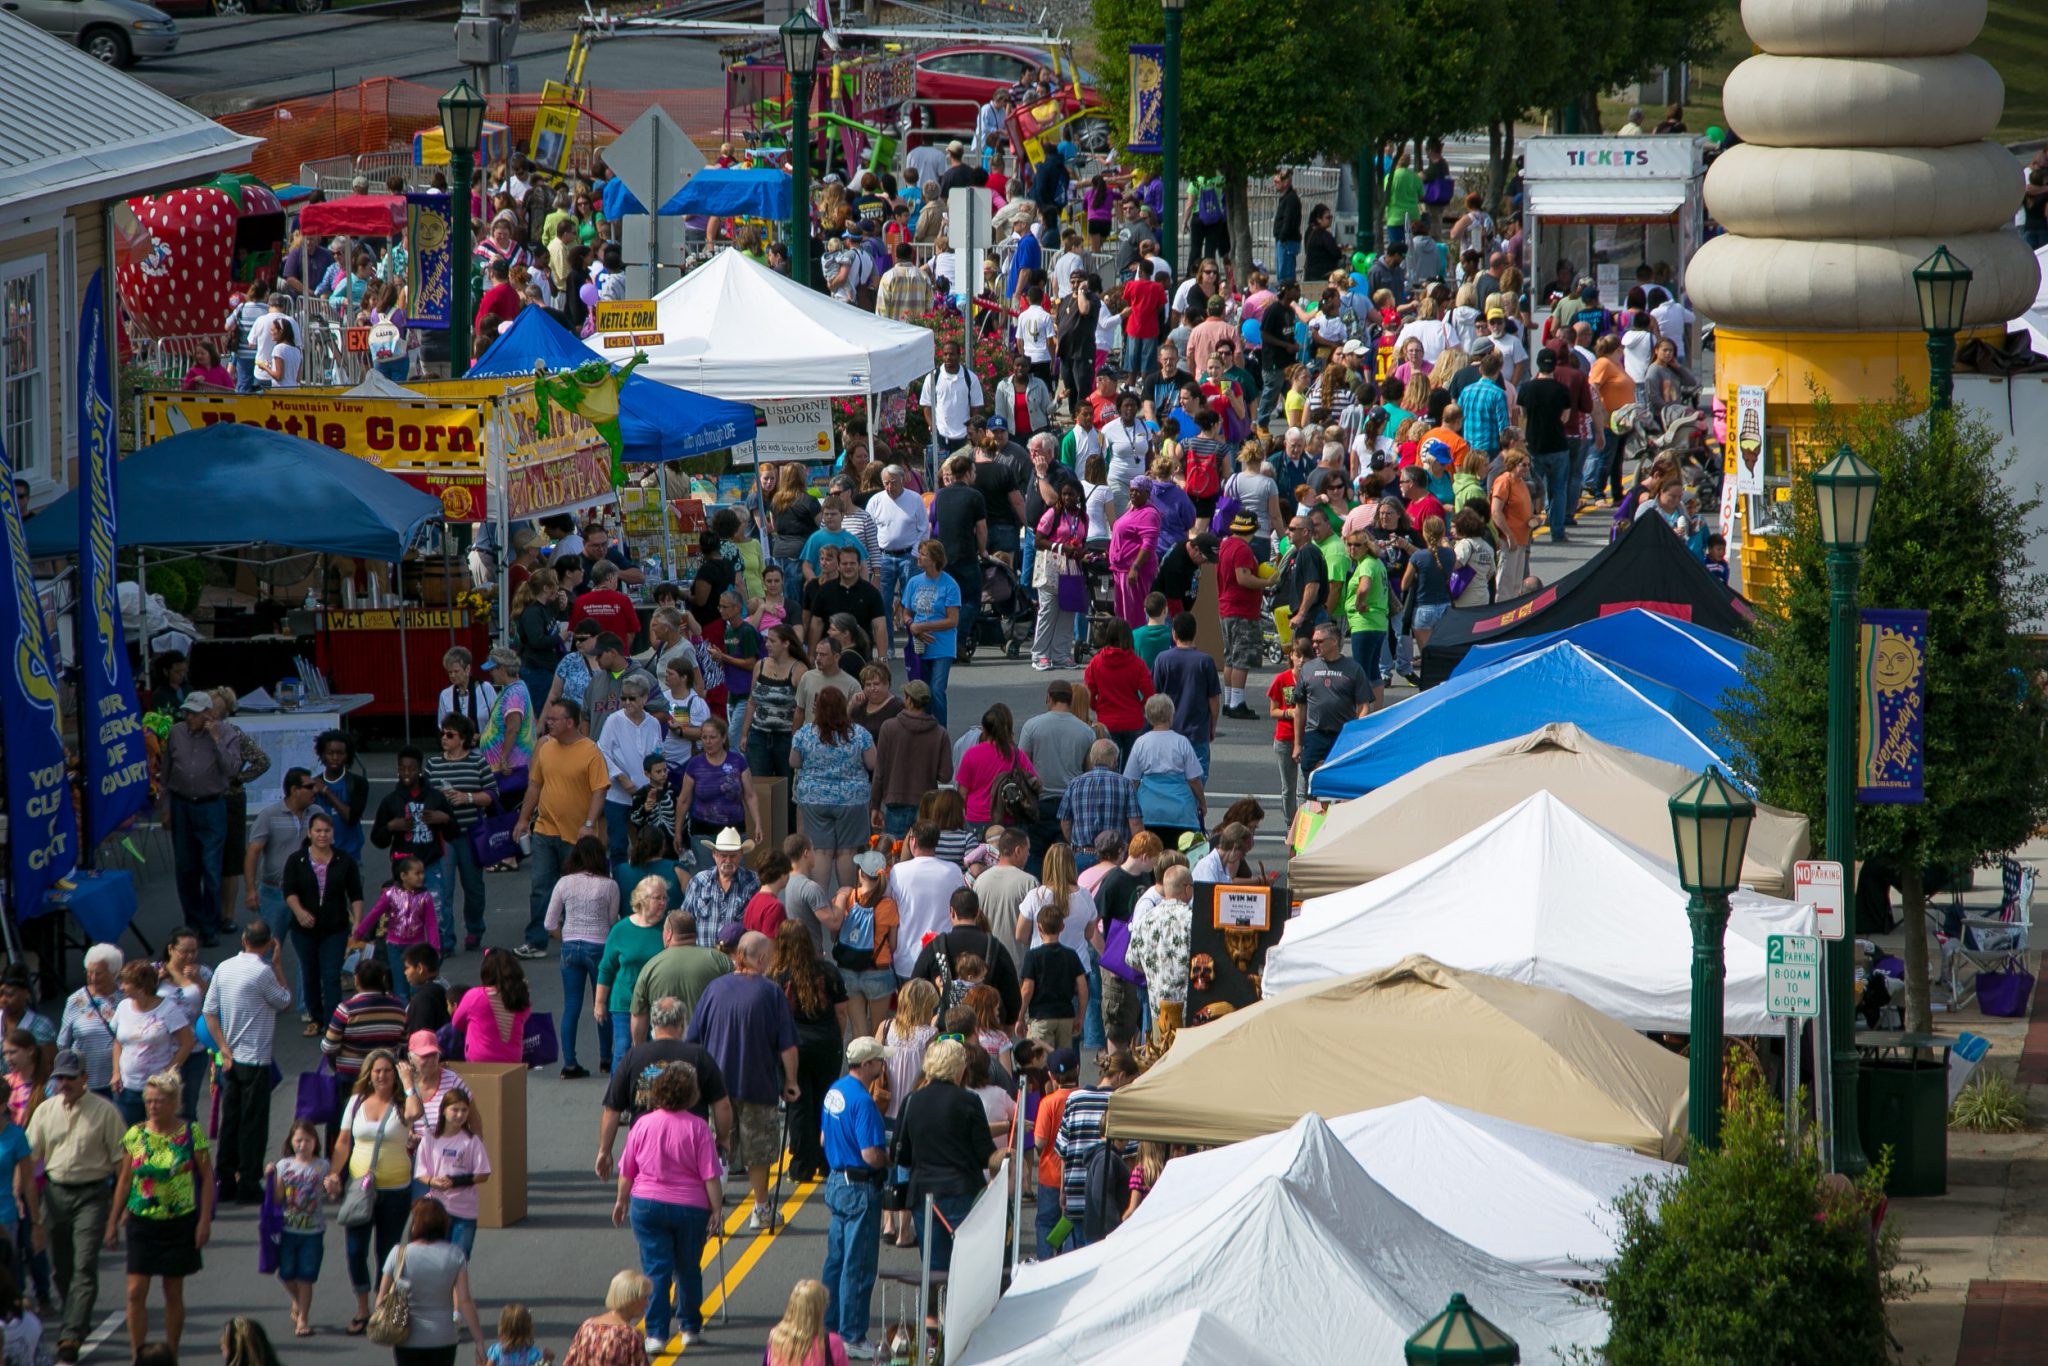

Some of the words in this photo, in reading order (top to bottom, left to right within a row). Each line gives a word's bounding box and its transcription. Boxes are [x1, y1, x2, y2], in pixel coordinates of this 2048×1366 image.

[1567, 150, 1649, 167] TICKETS
[416, 251, 450, 313] Everybody's
[430, 280, 448, 306] Day
[600, 312, 629, 329] KETTLE
[631, 311, 655, 328] CORN
[1026, 319, 1039, 342] 4
[606, 336, 632, 348] ICED
[639, 335, 662, 346] TEA
[272, 400, 330, 413] Mountain
[334, 402, 364, 413] View
[767, 400, 829, 416] USBORNE
[778, 412, 821, 425] BOOKS
[366, 416, 476, 452] Corn
[694, 431, 704, 452] you
[703, 425, 724, 447] through
[723, 422, 736, 439] LIFE
[1728, 406, 1736, 468] FLOAT
[736, 446, 748, 456] The
[748, 443, 767, 453] boks
[768, 441, 781, 452] kids
[781, 443, 794, 453] love
[794, 443, 804, 453] to
[804, 441, 818, 452] read
[427, 476, 448, 485] SWEET
[456, 477, 484, 485] UNSWEET
[527, 480, 564, 511] ICED
[566, 472, 596, 501] TEA
[331, 612, 363, 630] WET
[390, 610, 449, 628] WHISTLE
[1868, 692, 1921, 779] Everybody's
[1892, 737, 1918, 770] Day
[1797, 865, 1811, 881] NO
[1811, 869, 1840, 881] PARKING
[1228, 894, 1245, 902] WIN
[1246, 895, 1258, 903] ME
[1770, 939, 1782, 960] 2
[1793, 940, 1806, 950] HR
[1784, 952, 1816, 963] PARKING
[1774, 969, 1811, 980] 8:00AM
[1787, 982, 1799, 993] TO
[1774, 996, 1811, 1008] 6:00PM
